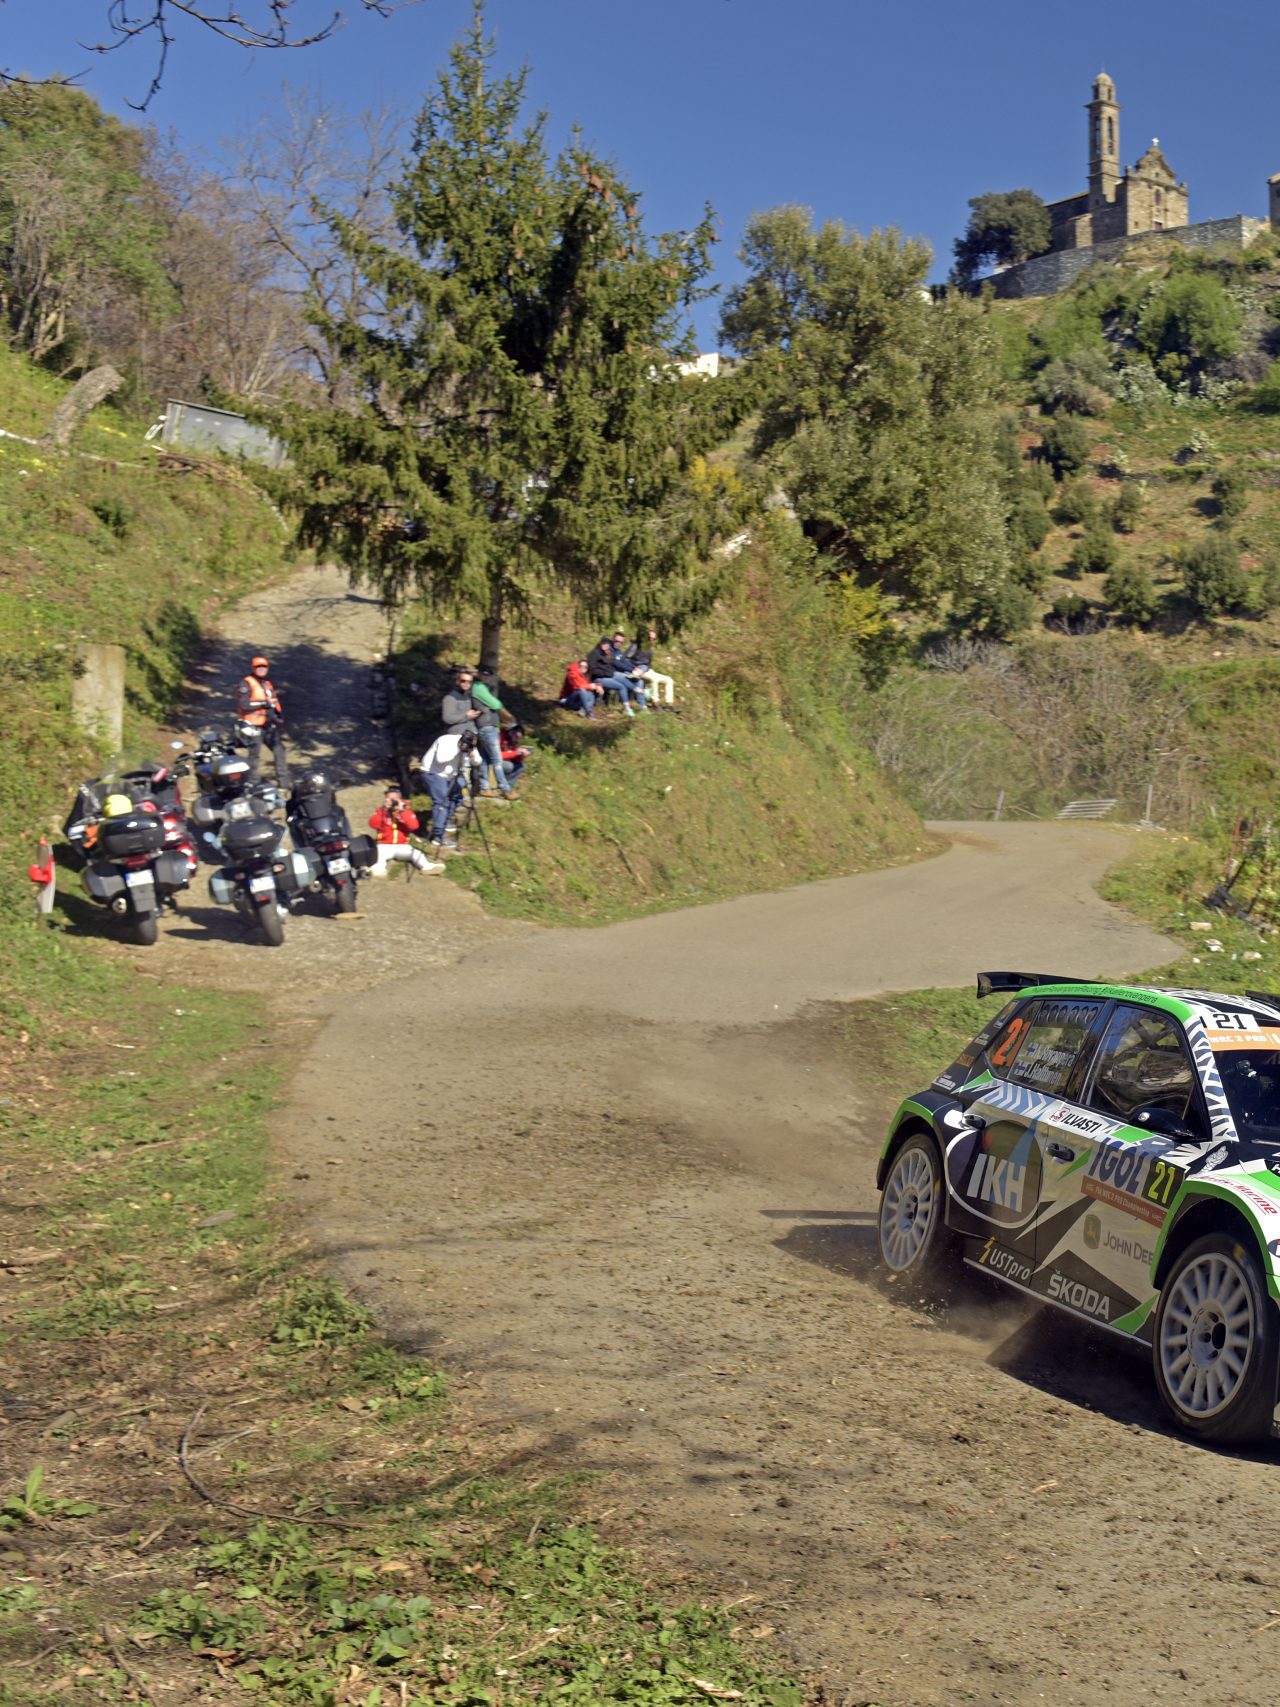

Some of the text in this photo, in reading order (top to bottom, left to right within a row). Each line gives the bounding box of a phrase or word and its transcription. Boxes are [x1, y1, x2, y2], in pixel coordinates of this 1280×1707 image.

[1213, 1013, 1247, 1029] 21
[991, 1018, 1030, 1067] 21
[1058, 1110, 1101, 1133] SILVASTI
[1088, 1137, 1175, 1204] IGOL 21
[1103, 1231, 1132, 1257] JOHN
[1048, 1270, 1110, 1320] ŠKODA
